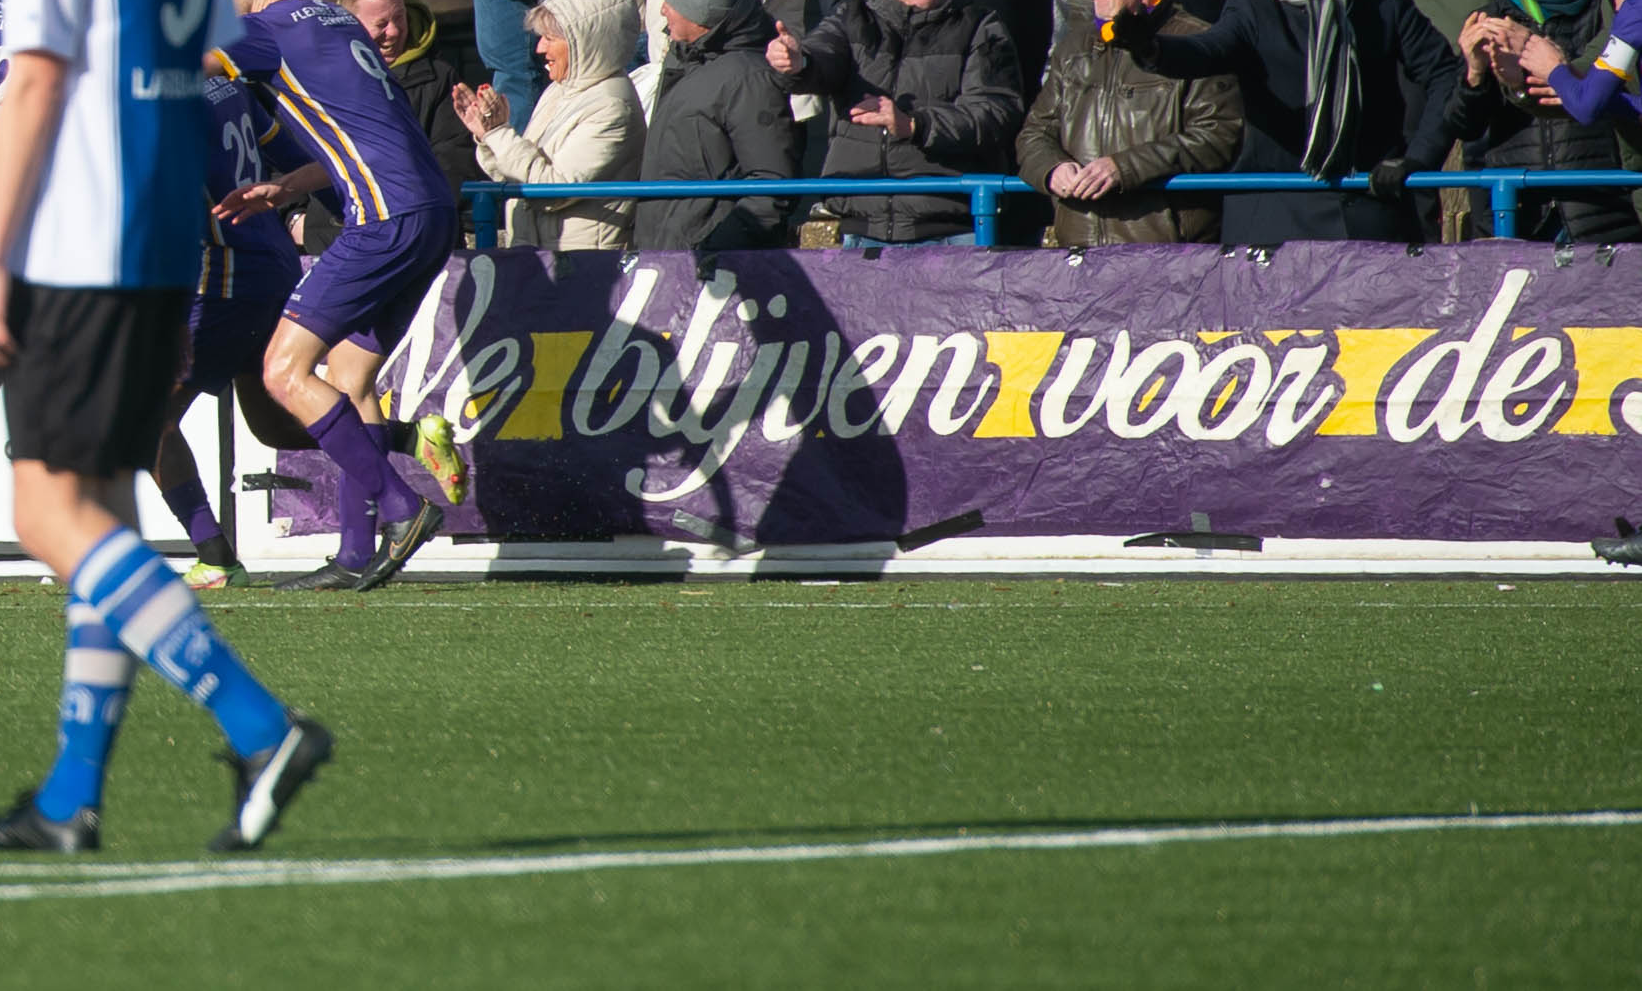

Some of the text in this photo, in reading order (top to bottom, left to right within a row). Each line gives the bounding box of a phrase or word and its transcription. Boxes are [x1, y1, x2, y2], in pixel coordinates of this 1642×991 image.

[350, 39, 395, 101] 9
[222, 113, 262, 190] 29
[571, 268, 1000, 502] blijven
[1040, 328, 1337, 447] voor
[1385, 268, 1567, 443] de
